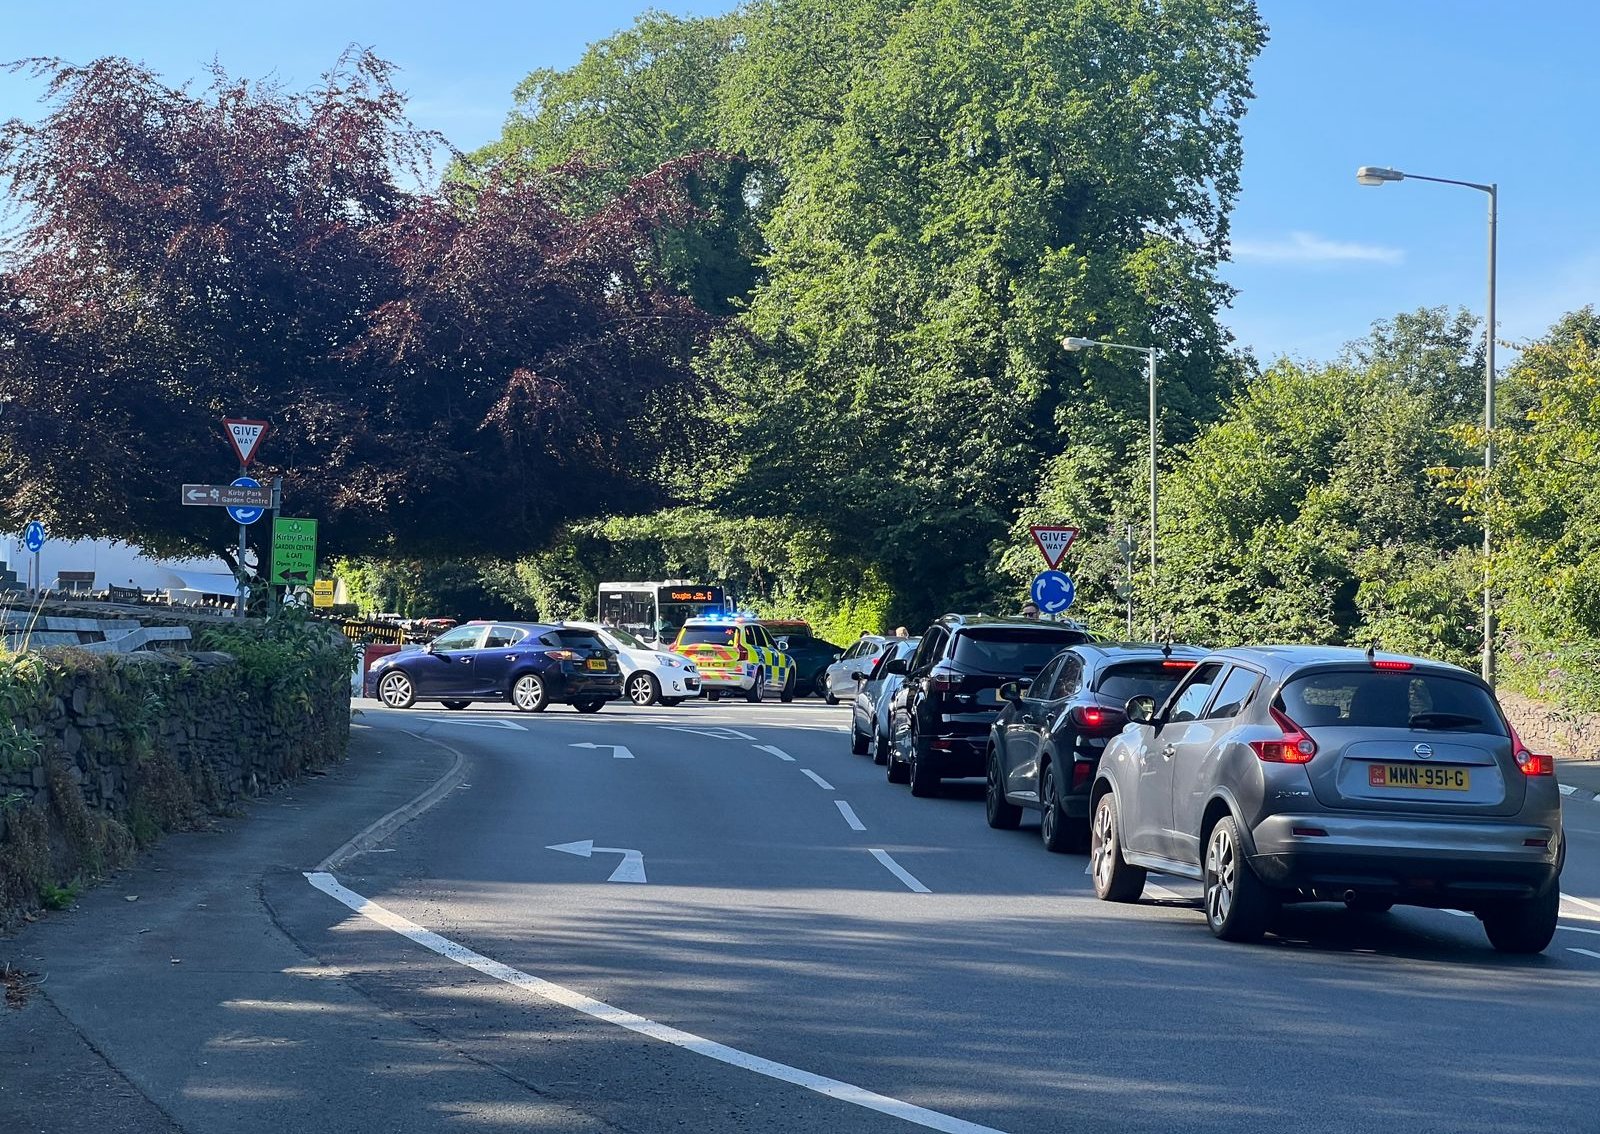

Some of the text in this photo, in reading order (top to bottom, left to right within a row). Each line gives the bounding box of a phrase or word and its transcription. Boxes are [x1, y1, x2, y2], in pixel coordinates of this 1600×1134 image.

[233, 426, 258, 436] GIVE
[276, 532, 296, 542] Kirby
[1040, 532, 1067, 541] GIVE
[275, 542, 295, 550] GARDEN
[671, 591, 712, 600] Douglas 6
[1389, 766, 1464, 786] MMN-951-G
